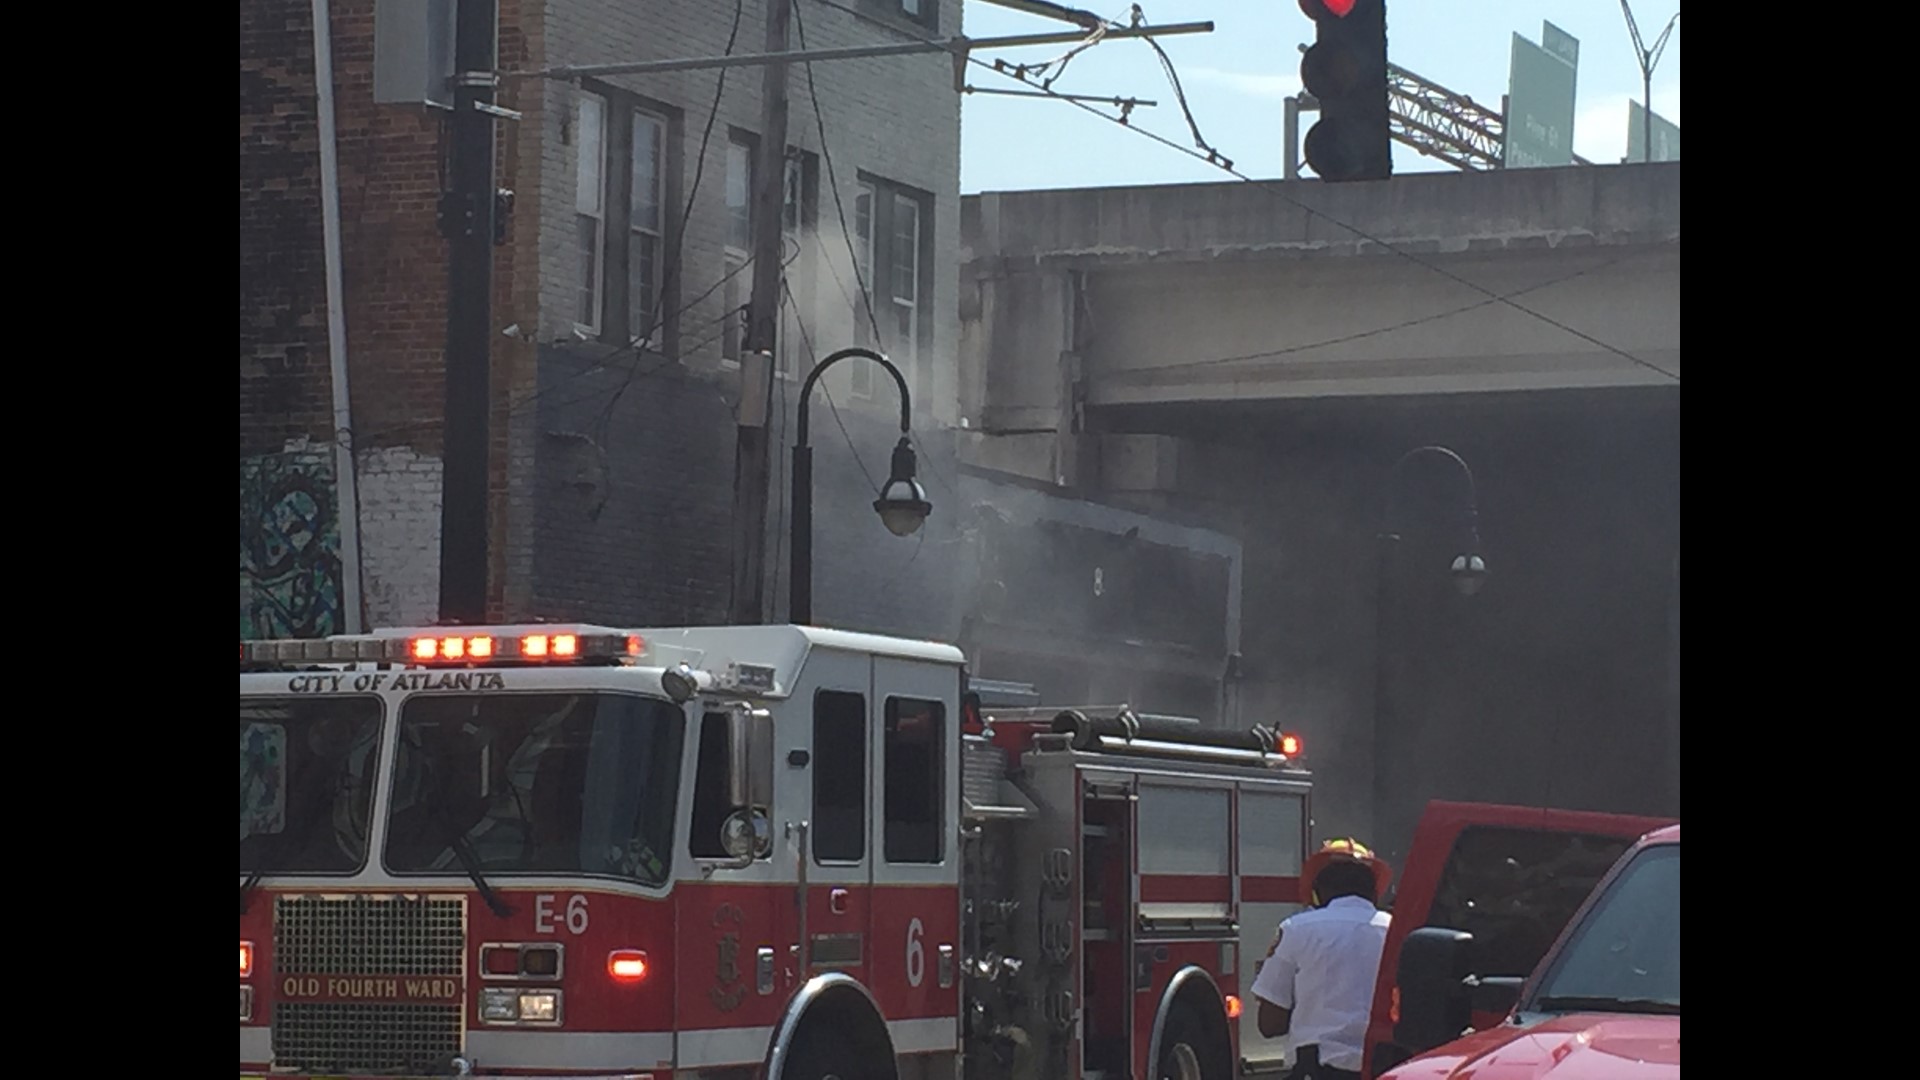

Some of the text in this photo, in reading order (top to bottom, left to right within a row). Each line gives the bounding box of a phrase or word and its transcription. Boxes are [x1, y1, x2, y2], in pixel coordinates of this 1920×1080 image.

[289, 672, 505, 693] CITY OF ATLANTA
[535, 894, 589, 934] E-6
[906, 917, 924, 987] 6
[284, 978, 456, 999] OLD FOURTH WARD
